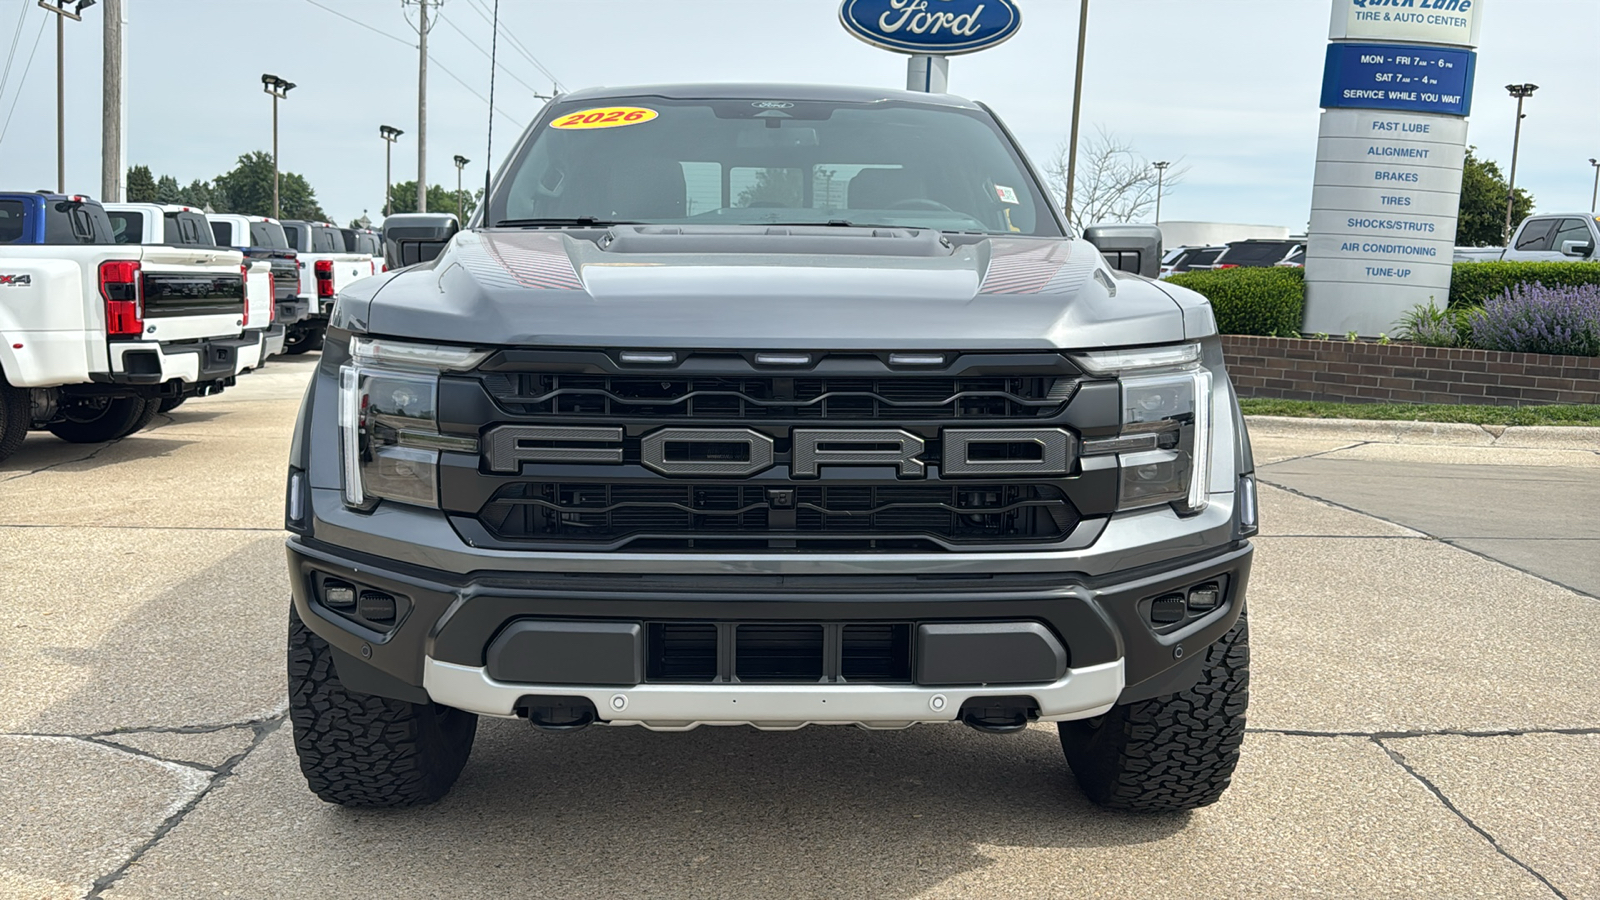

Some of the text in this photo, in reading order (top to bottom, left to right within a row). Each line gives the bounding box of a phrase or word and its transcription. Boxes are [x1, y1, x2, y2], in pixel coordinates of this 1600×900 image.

[879, 0, 985, 36] Ford
[1355, 11, 1467, 28] TIRE & AUTO CENTER
[1360, 54, 1384, 64] MON
[1395, 56, 1411, 65] FRI
[1375, 73, 1393, 82] SAT
[1343, 89, 1461, 105] SERVICE WHILE YOU WAIT
[559, 110, 647, 127] 2026
[1372, 121, 1430, 134] FAST LUBE
[1367, 146, 1430, 159] ALIGNMENT
[1374, 171, 1419, 183] BRAKES
[1380, 195, 1411, 206] TIRES
[1347, 217, 1435, 233] SHOCKS/STRUTS
[1340, 242, 1437, 257] AIR CONDITIONING
[1365, 267, 1411, 278] TUNE-UP
[484, 425, 1076, 479] FORD
